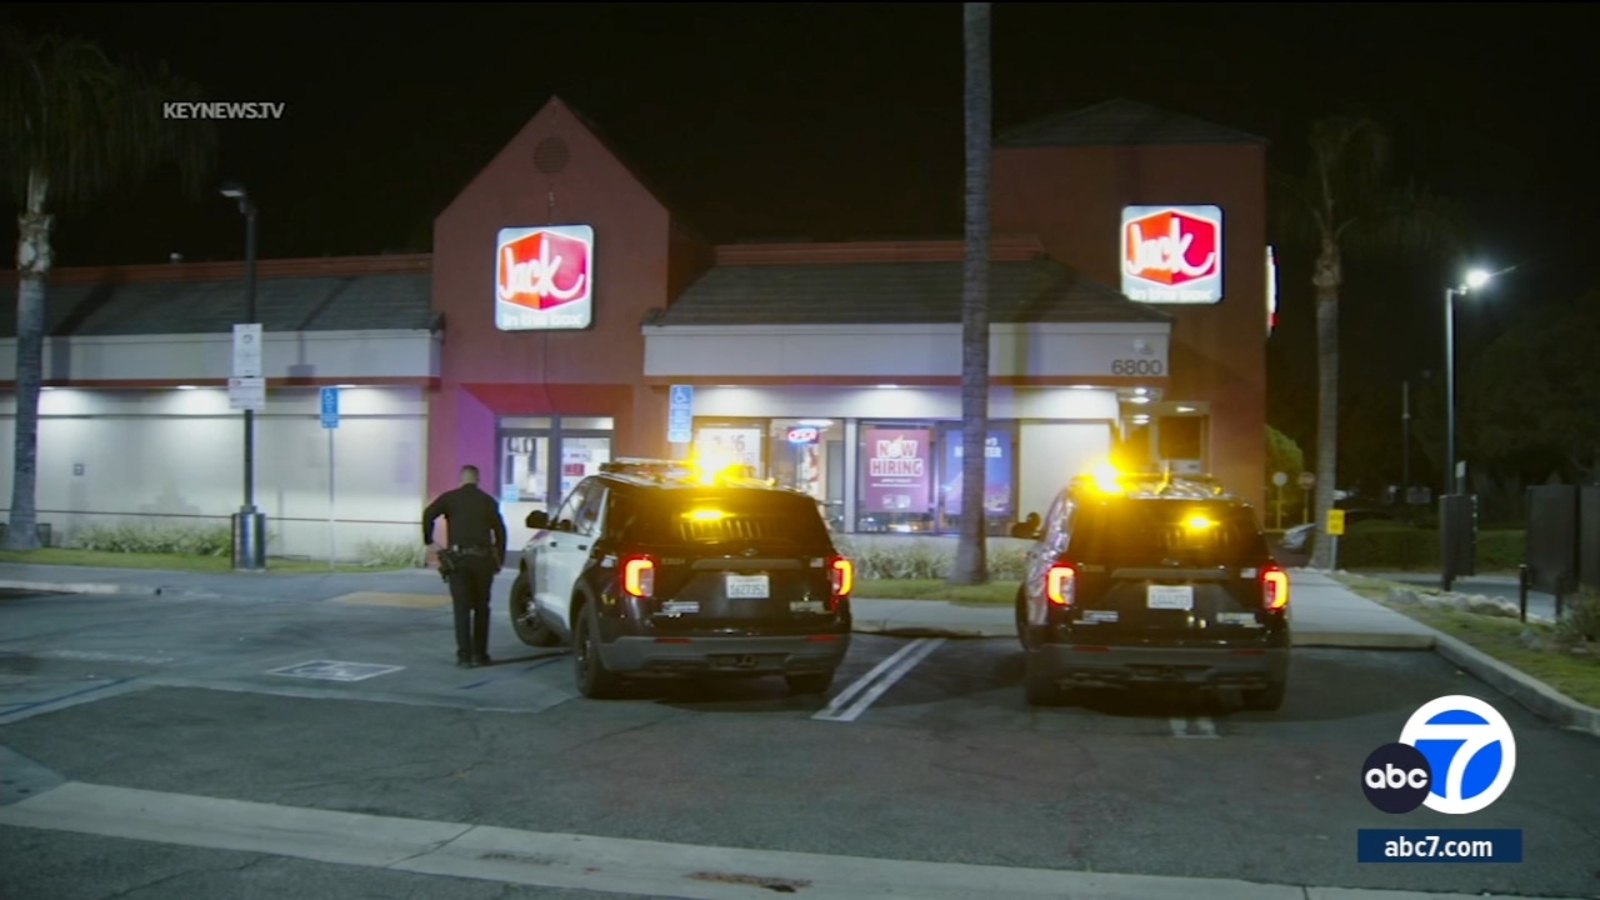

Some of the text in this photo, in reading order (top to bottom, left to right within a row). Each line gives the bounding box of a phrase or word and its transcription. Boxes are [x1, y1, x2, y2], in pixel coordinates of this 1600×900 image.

[1127, 217, 1216, 276] Jack
[500, 237, 585, 299] Jack
[1111, 359, 1163, 375] 6800
[870, 458, 924, 477] HIRING
